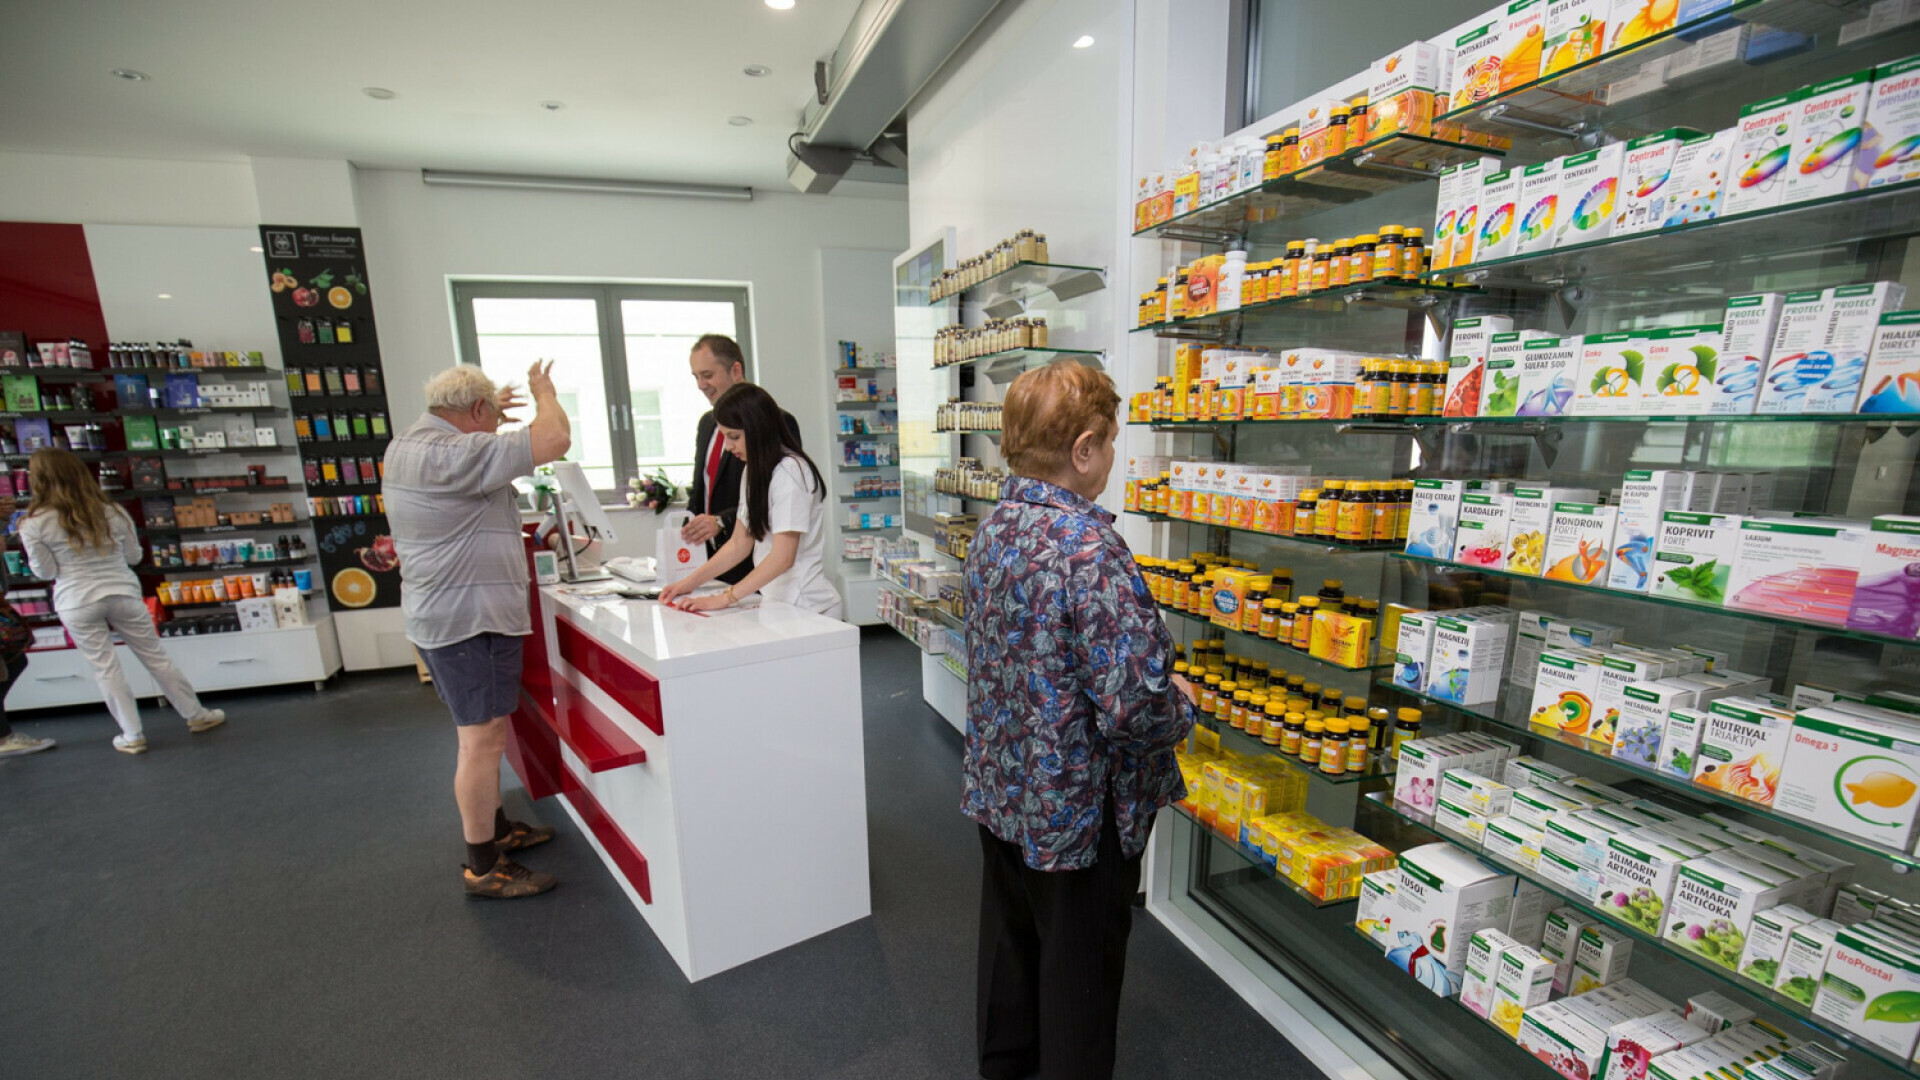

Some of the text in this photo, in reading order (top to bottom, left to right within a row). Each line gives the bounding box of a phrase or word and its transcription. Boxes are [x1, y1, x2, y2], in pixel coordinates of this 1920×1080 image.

[1550, 2, 1568, 17] BETA
[1457, 34, 1500, 57] ANTISKLERIN
[1804, 94, 1852, 115] Centravit
[1743, 113, 1786, 132] Centravit
[1629, 146, 1665, 164] Centravit
[1564, 165, 1598, 181] CENTRAVIT
[1525, 174, 1557, 188] CENTRAVIT
[1485, 182, 1515, 197] CENTRAVIT
[1785, 303, 1824, 315] PROTECT
[1833, 297, 1877, 310] PROTECT
[1729, 308, 1766, 318] PROTECT
[1792, 314, 1817, 322] KREMA
[1841, 308, 1868, 317] KREMA
[1736, 318, 1760, 326] KREMA
[1824, 310, 1841, 345] HEMERO
[1722, 319, 1735, 353] HEMERO
[1776, 316, 1792, 350] HEMERO
[1879, 340, 1916, 351] DIRECT
[1525, 351, 1574, 362] GLUKOZAMIN
[1524, 360, 1566, 370] SULFAT 500
[1415, 491, 1456, 503] KALCIJ CITRAT
[1463, 506, 1504, 518] KARDALEPT
[1554, 525, 1578, 536] FORTE
[1555, 516, 1604, 530] KONDROIN
[1665, 525, 1715, 539] KOPRIVIT
[1663, 535, 1686, 546] FORTE
[1876, 543, 1920, 558] Magnez
[1437, 631, 1470, 647] MAGNEZIJ
[1541, 667, 1576, 682] MAKULIN
[1603, 670, 1637, 684] MAKULIN
[1624, 700, 1662, 715] METABOLAN
[1709, 727, 1757, 748] TRIAKTIV
[1711, 718, 1767, 742] NUTRIVAL
[1795, 733, 1829, 750] Omega
[1831, 744, 1839, 753] 3
[1609, 850, 1657, 879] SILIMARIN
[1400, 874, 1424, 897] TUSOL
[1681, 879, 1738, 910] SILIMARIN
[1548, 924, 1567, 939] TUSOL
[1754, 924, 1783, 941] SINUSAN
[1470, 946, 1490, 962] TUSOL
[1580, 942, 1601, 958] TUSOL
[1793, 941, 1823, 960] SINUSAN
[1503, 962, 1522, 980] TUSOL
[1837, 950, 1893, 982] UroProstal
